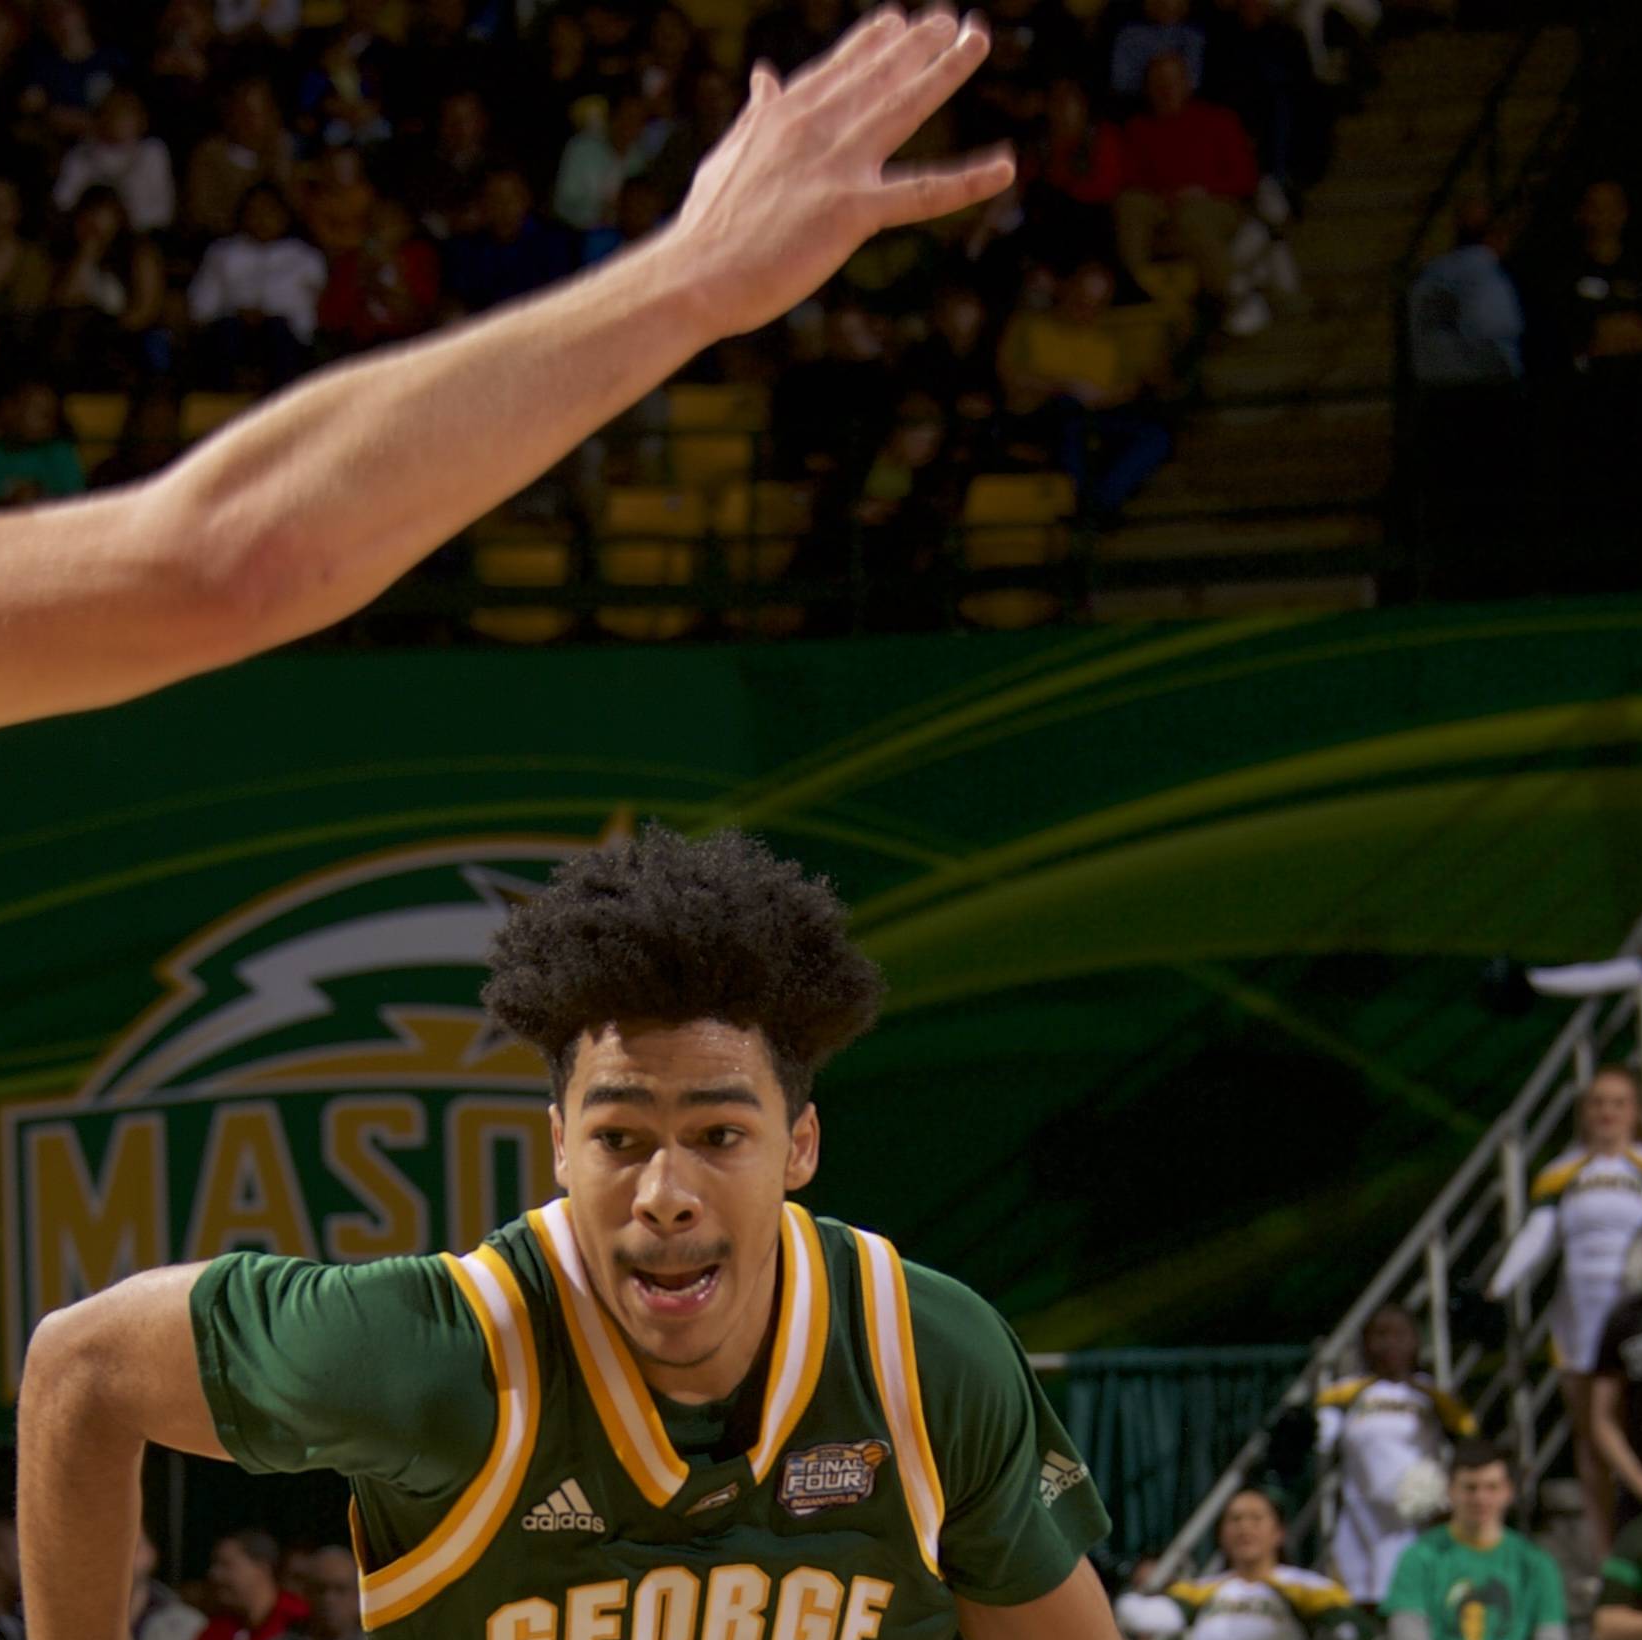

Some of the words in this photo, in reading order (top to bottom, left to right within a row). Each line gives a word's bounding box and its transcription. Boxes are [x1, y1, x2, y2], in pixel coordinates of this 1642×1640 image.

[23, 1094, 561, 1312] MASO
[806, 1459, 864, 1474] FINAL
[787, 1471, 863, 1493] FOUR
[521, 1510, 606, 1533] adidas
